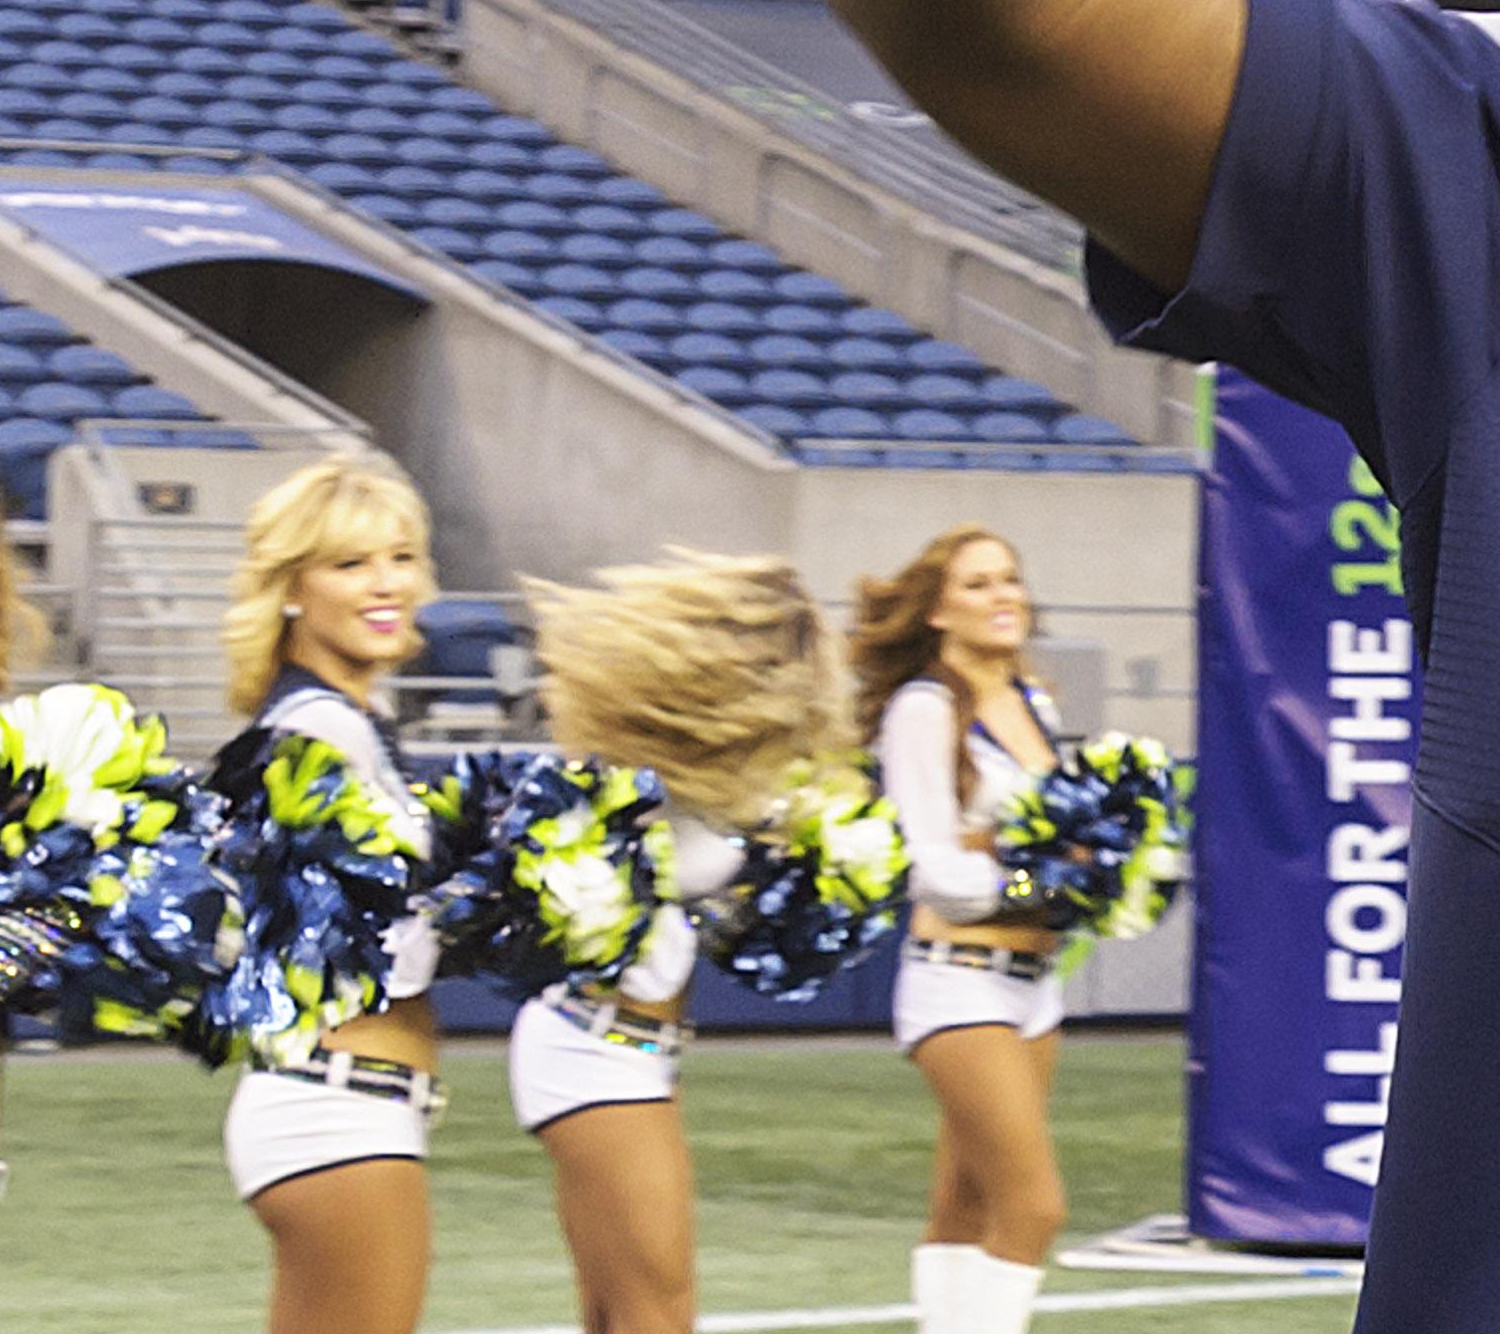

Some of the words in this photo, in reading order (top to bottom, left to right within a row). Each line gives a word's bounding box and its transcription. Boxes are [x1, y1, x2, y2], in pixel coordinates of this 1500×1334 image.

[1326, 619, 1414, 801] THE
[1325, 824, 1409, 1003] FOR
[1323, 1022, 1398, 1188] ALL
